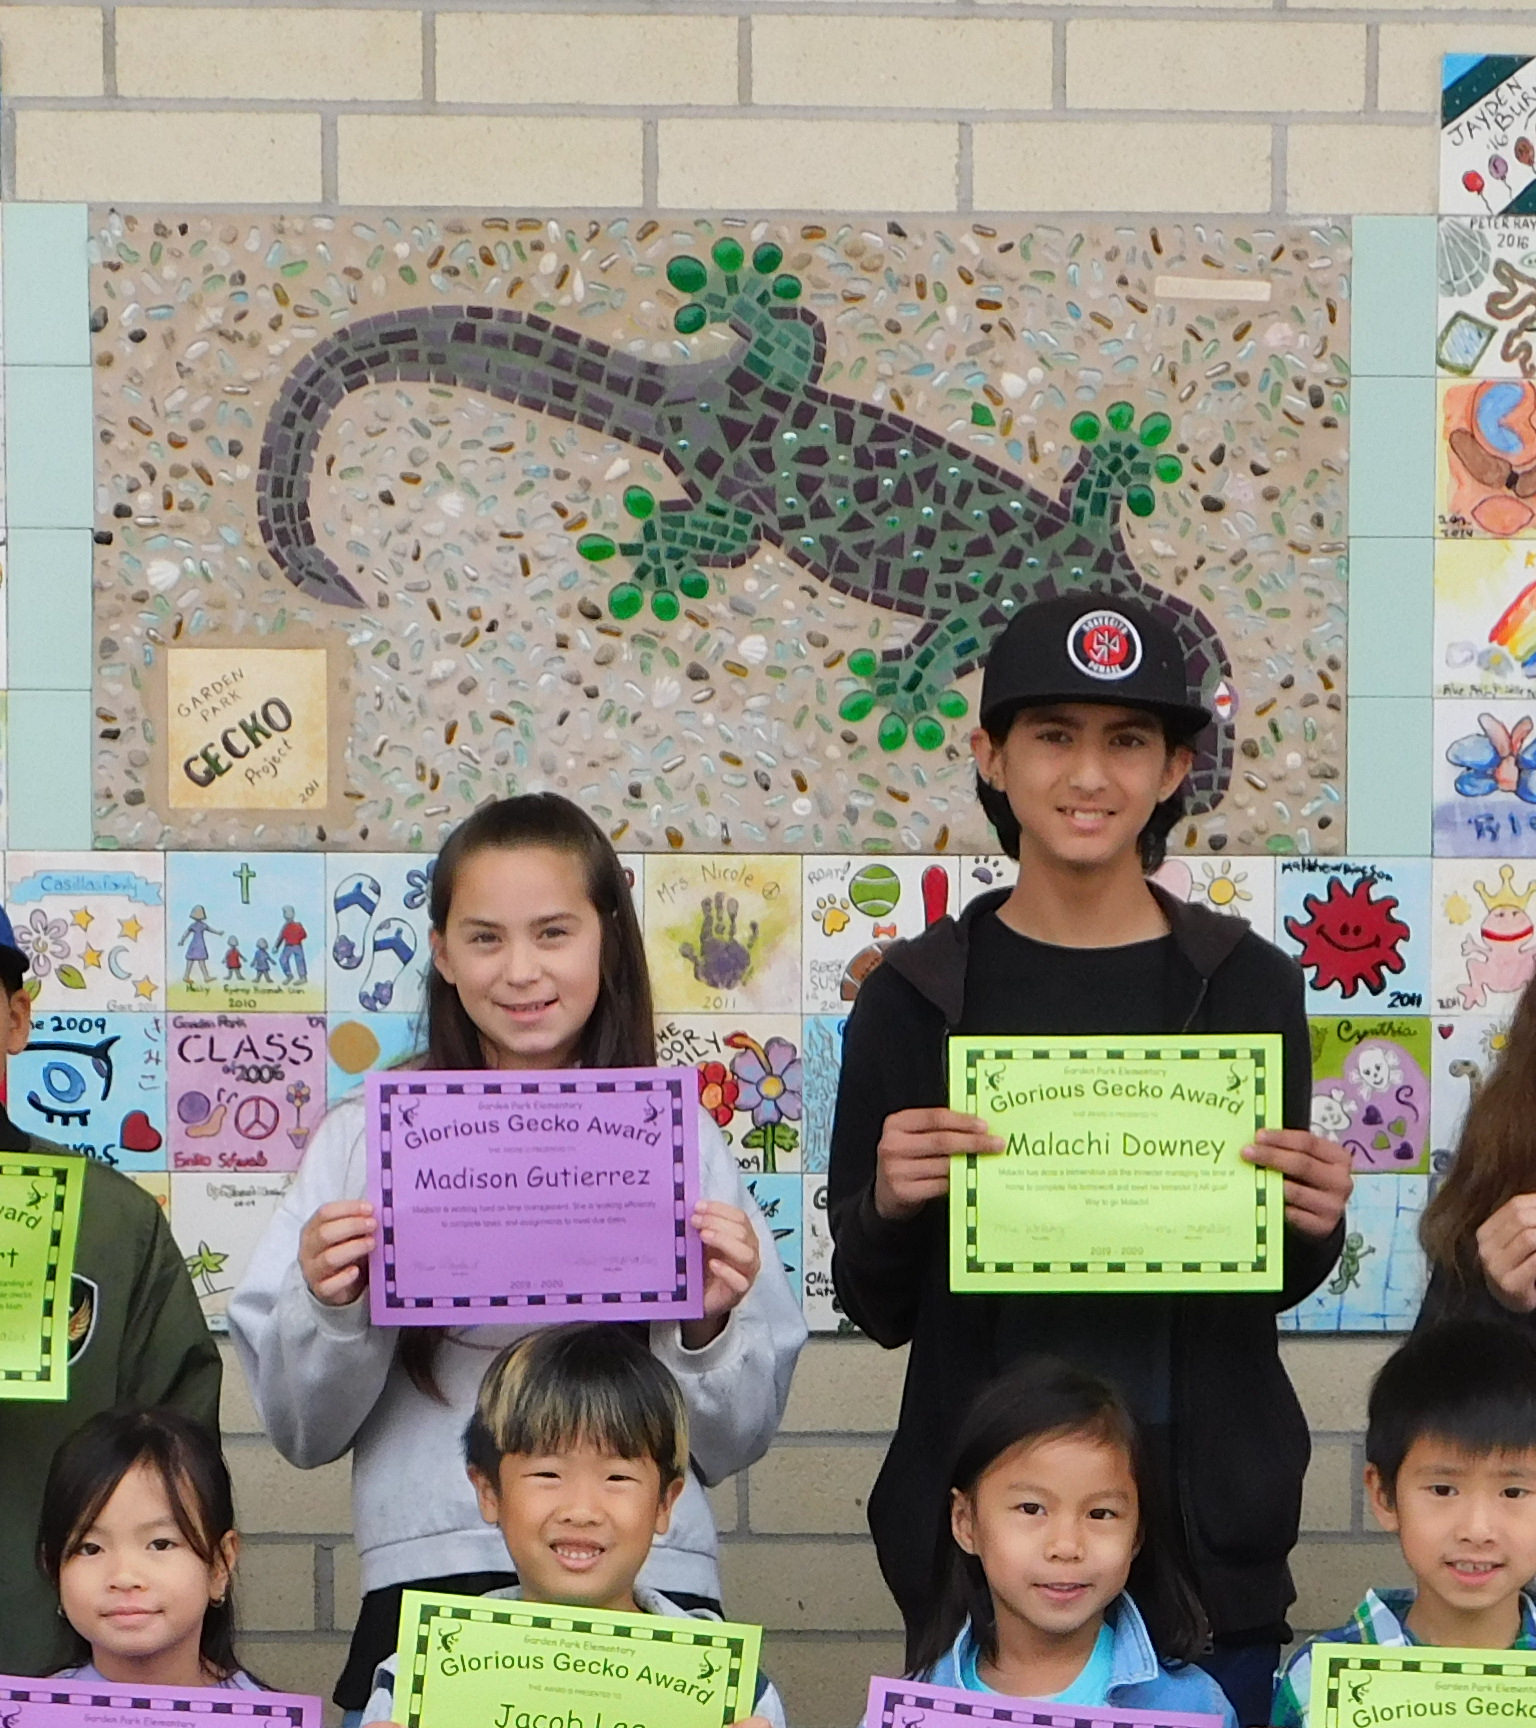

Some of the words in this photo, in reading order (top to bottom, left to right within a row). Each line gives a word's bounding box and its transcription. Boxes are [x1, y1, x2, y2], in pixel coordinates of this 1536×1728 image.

[1446, 76, 1524, 147] JAYDEN
[1470, 217, 1512, 231] PETER
[177, 667, 245, 718] GARDEN
[200, 690, 242, 722] PARK
[183, 697, 292, 788] GECKO
[244, 737, 293, 786] Project
[298, 780, 320, 804] 2011
[655, 876, 689, 904] Mrs
[701, 862, 755, 887] Nicole
[702, 995, 736, 1009] 2011
[1387, 991, 1423, 1009] 2011
[53, 1017, 106, 1034] 2009
[1337, 1019, 1417, 1042] Cynthia
[177, 1033, 313, 1066] CLASS
[991, 1083, 1085, 1113] Glorious
[1094, 1080, 1163, 1098] Gecko
[1170, 1084, 1244, 1115] Award
[405, 1117, 499, 1149] Glorious
[508, 1114, 579, 1133] Gecko
[587, 1116, 661, 1146] Award
[1006, 1131, 1109, 1156] Malachi
[1123, 1133, 1225, 1164] Downey
[415, 1168, 517, 1190] Madison
[527, 1166, 650, 1188] Gutierrez
[524, 1635, 556, 1646] Garden
[560, 1638, 581, 1649] Park
[583, 1640, 636, 1657] Elementary
[441, 1651, 544, 1676] Glorious
[553, 1653, 629, 1679] Gecko
[636, 1665, 714, 1705] Award
[1353, 1700, 1456, 1728] Glorious
